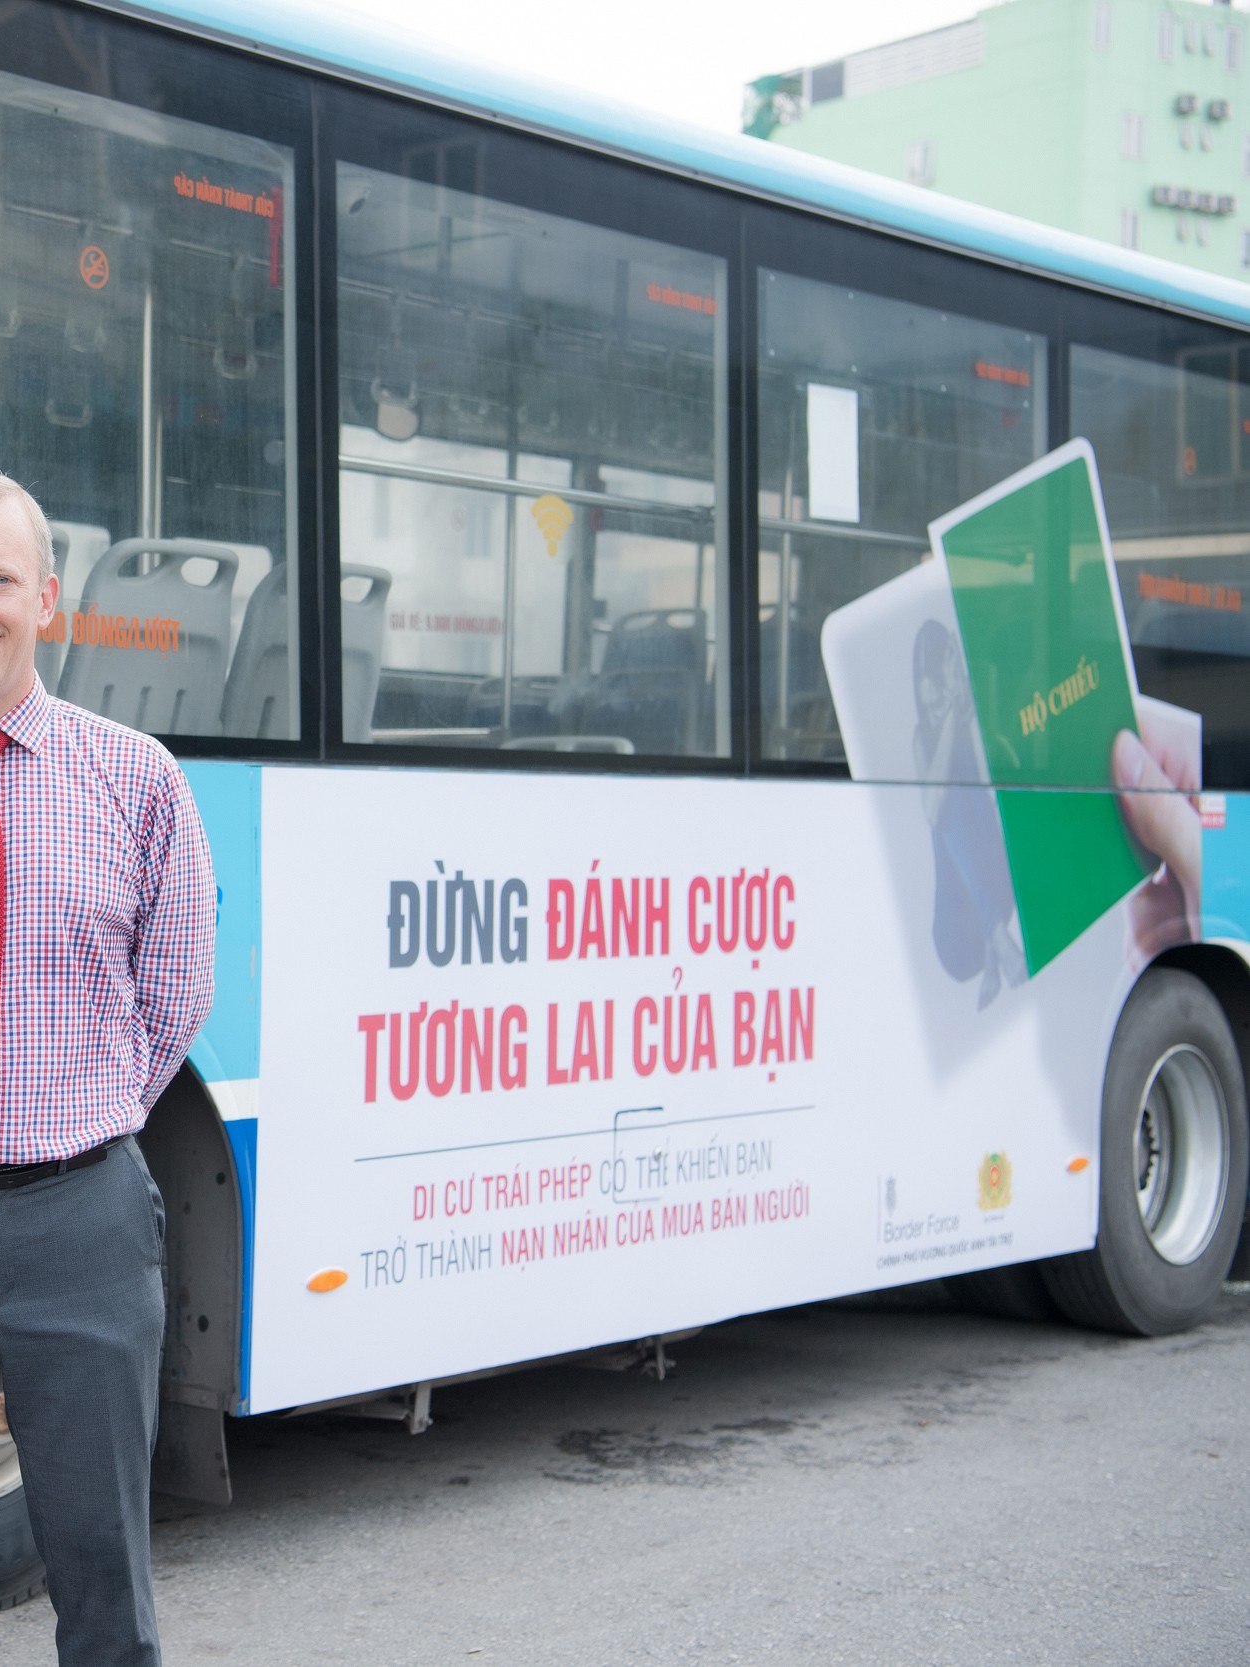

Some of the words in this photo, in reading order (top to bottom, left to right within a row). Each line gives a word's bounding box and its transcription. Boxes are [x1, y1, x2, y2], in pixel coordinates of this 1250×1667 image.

[72, 601, 180, 660] ĐỒNG/LƯỢT
[1019, 690, 1047, 737] HỘ
[1048, 655, 1099, 716] CHIẾU
[387, 860, 528, 968] ĐỪNG
[546, 859, 670, 960] ĐÁNH
[688, 867, 795, 969] CƯỢC
[358, 1000, 528, 1103] TƯƠNG
[547, 1000, 614, 1085] LAI
[633, 966, 717, 1077] CỦA
[733, 987, 815, 1082] BẠN
[413, 1184, 434, 1221] DI
[444, 1172, 474, 1216] CƯ
[482, 1163, 529, 1211] TRÁI
[539, 1155, 591, 1203] PHÉP
[600, 1150, 627, 1195] CÓ
[676, 1134, 730, 1183] KHIẾN
[737, 1139, 772, 1179] BẠN
[360, 1235, 406, 1289] TRỞ
[415, 1229, 491, 1279] THÀNH
[502, 1226, 544, 1271] NẠN
[553, 1209, 607, 1257] NHÂN
[616, 1200, 655, 1246] CỦA
[662, 1201, 704, 1239] MUA
[711, 1188, 747, 1230] BÁN
[754, 1178, 810, 1224] NGƯỜI
[883, 1220, 924, 1243] Border
[927, 1213, 959, 1236] Force
